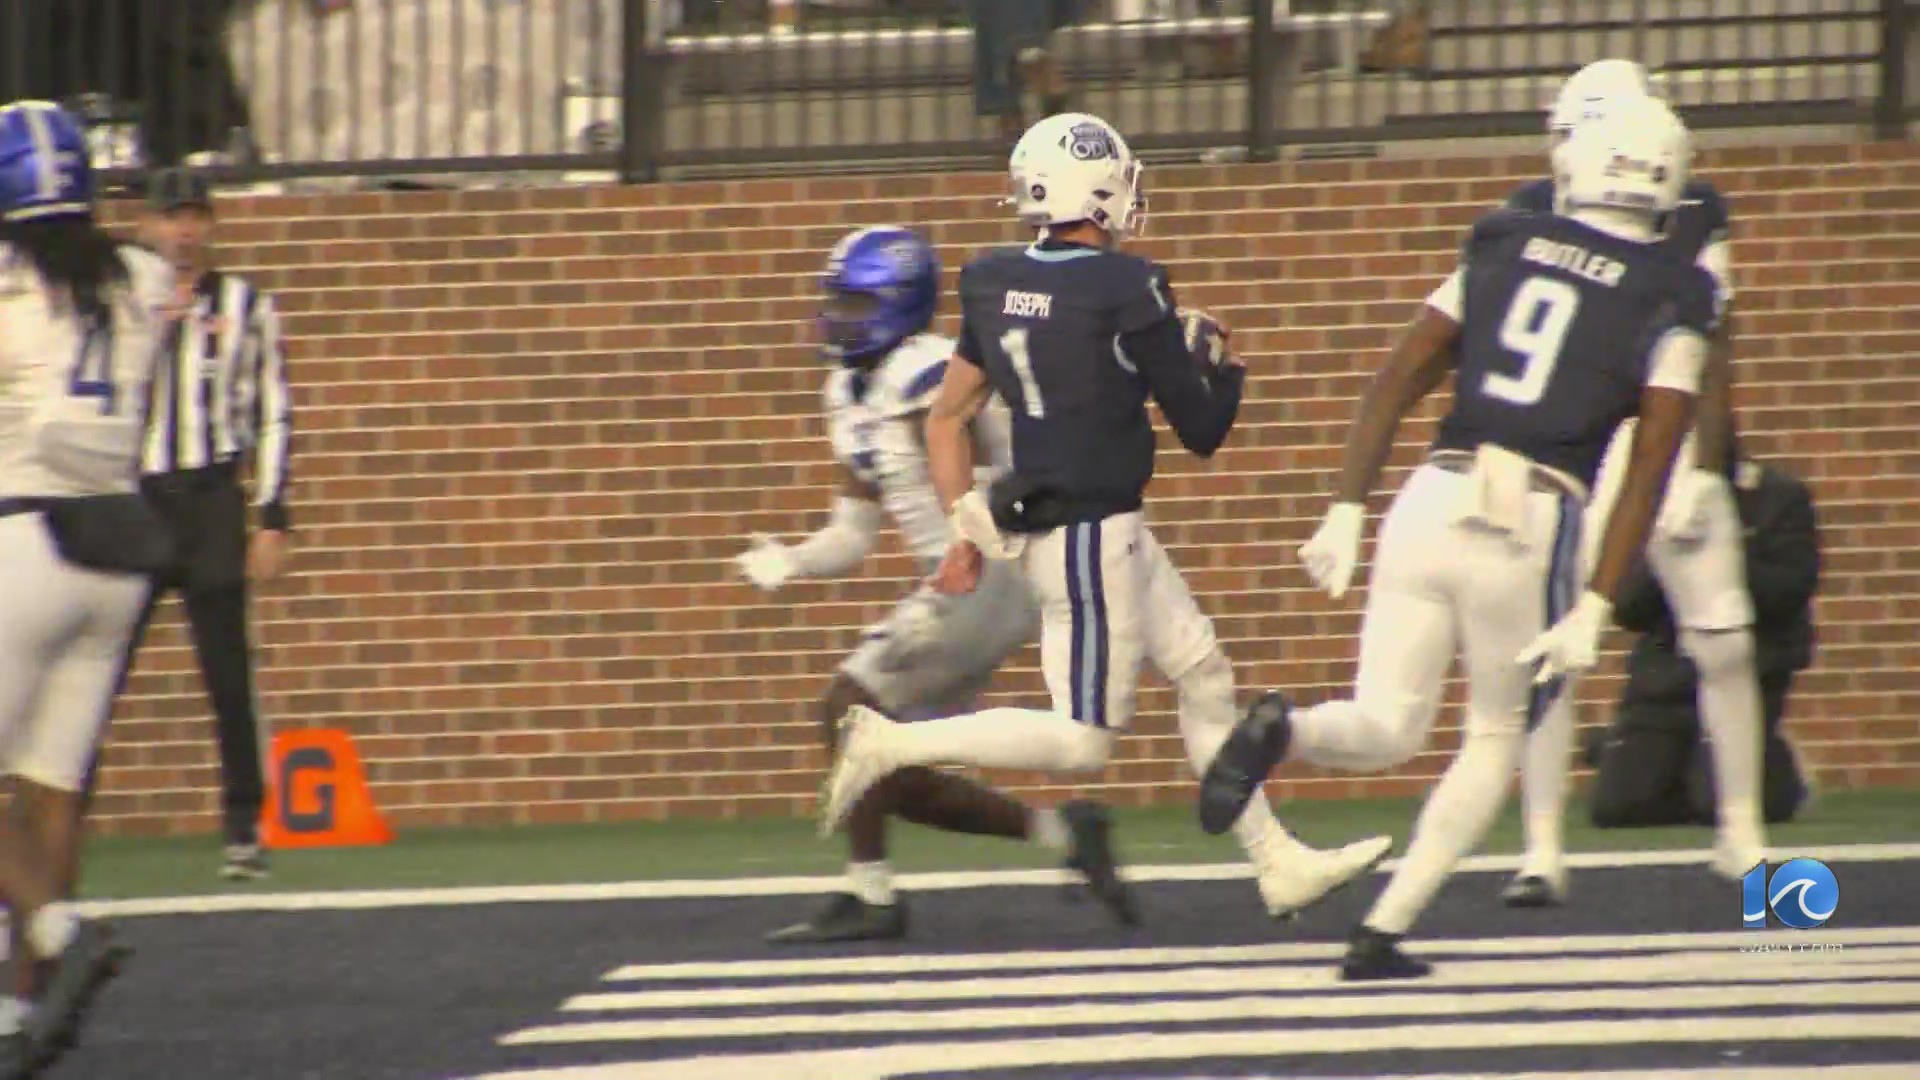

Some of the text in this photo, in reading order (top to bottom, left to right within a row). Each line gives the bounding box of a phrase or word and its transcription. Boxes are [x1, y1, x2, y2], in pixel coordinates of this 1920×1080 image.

[1003, 289, 1052, 317] JOSEPH
[1521, 236, 1627, 288] BUTLER
[1000, 328, 1044, 419] 1
[1481, 276, 1580, 405] 9
[281, 748, 335, 832] G
